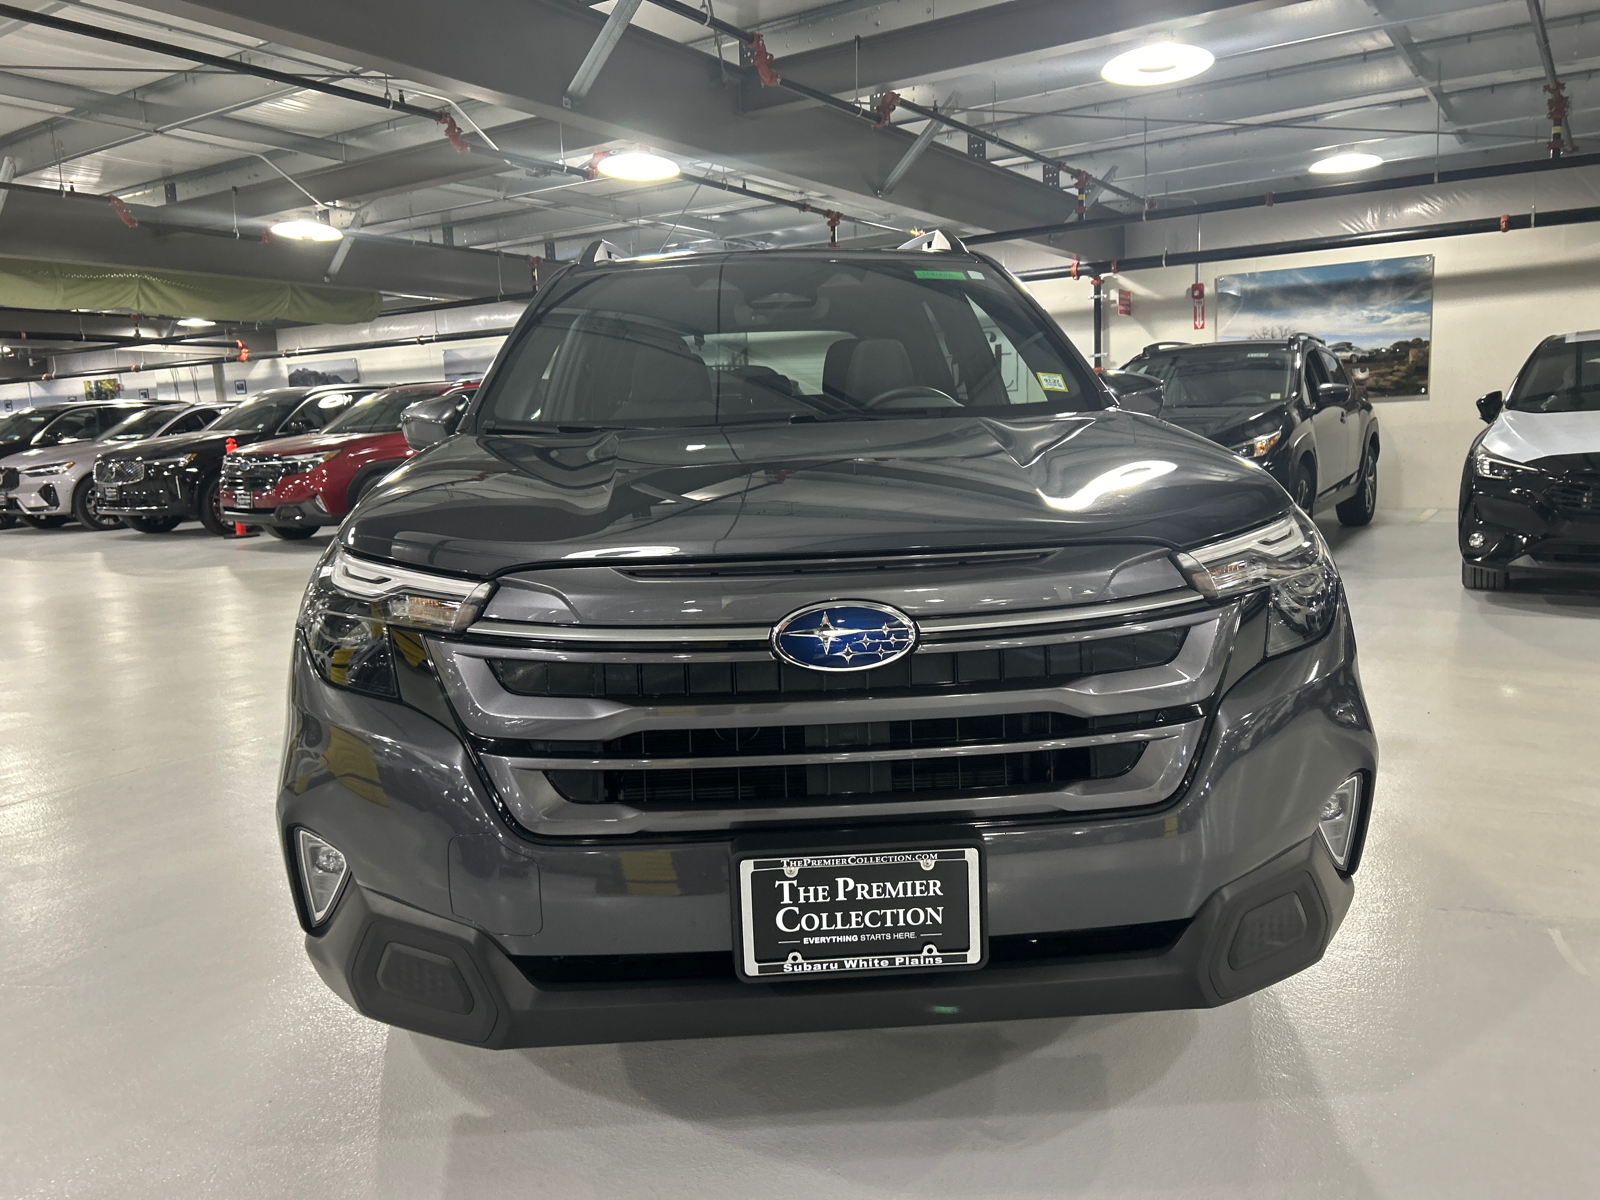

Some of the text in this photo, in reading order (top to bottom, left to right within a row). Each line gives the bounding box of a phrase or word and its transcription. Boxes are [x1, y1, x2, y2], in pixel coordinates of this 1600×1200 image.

[775, 877, 944, 904] THE PREMIER
[775, 906, 944, 932] COLLECTION
[803, 932, 917, 945] EVERYTHING STARTS HERE.
[783, 955, 943, 972] Subaru White Plains
